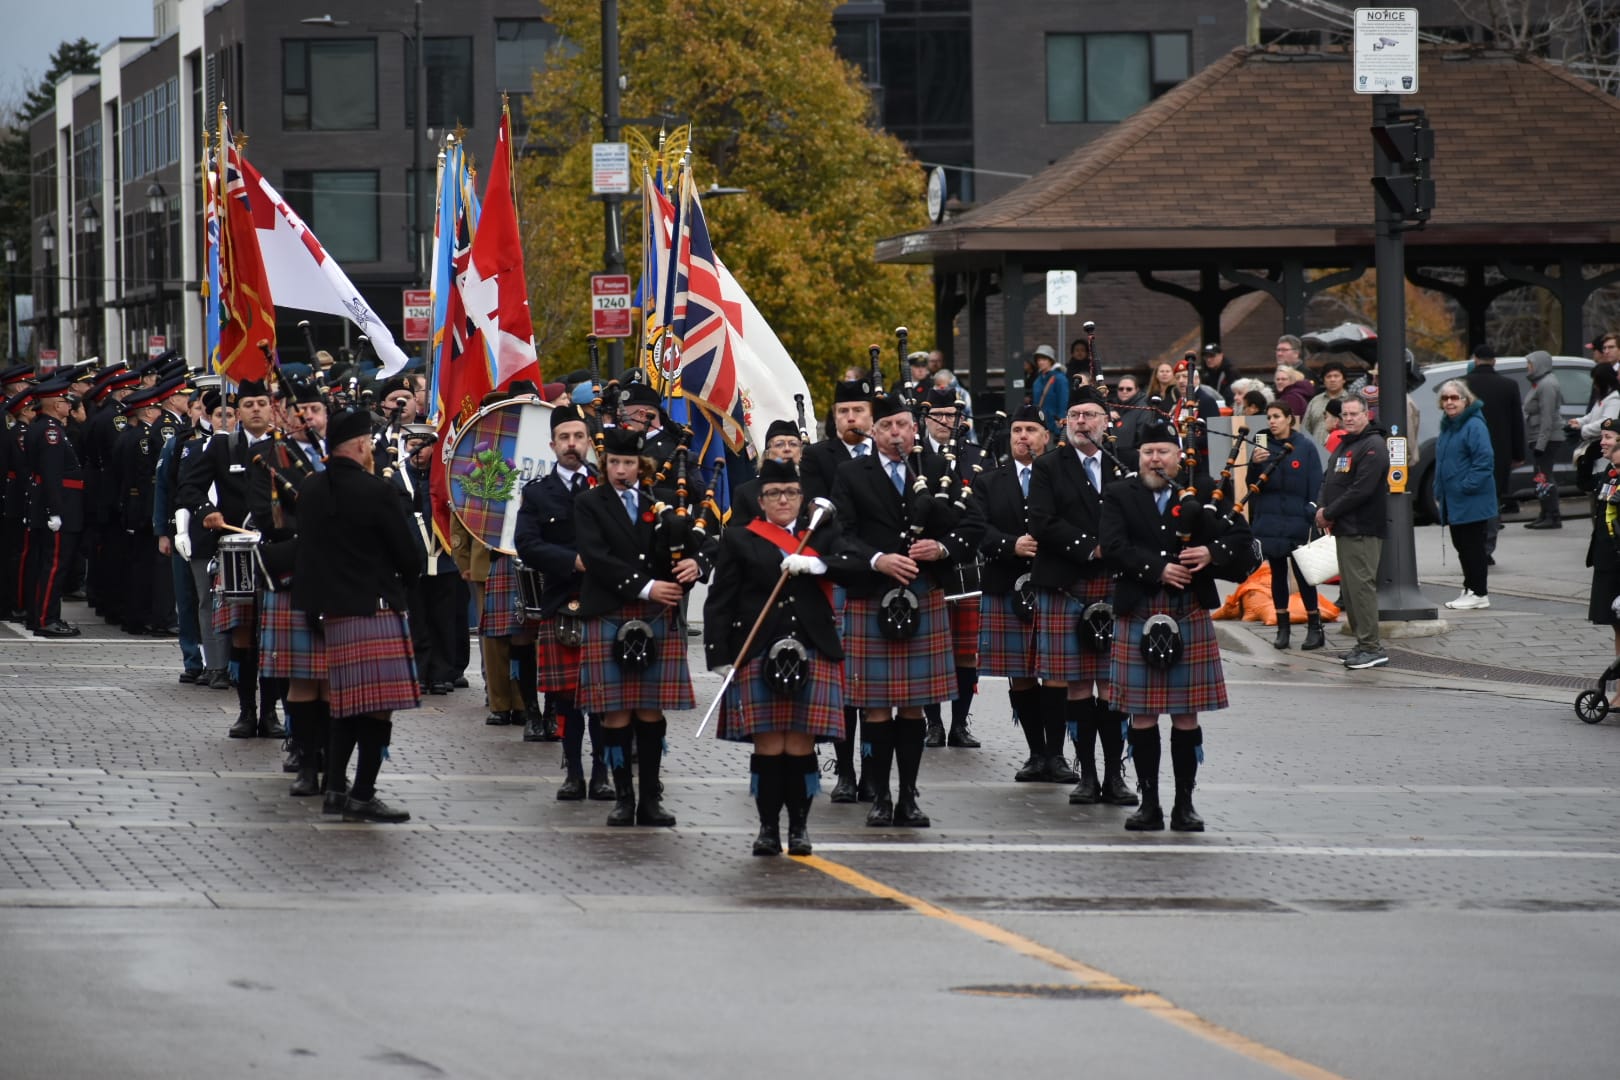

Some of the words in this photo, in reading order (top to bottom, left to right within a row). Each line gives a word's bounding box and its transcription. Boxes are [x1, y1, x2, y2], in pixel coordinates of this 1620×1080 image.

[1367, 11, 1405, 20] NOTICE
[597, 297, 625, 308] 1240
[519, 456, 557, 481] BA
